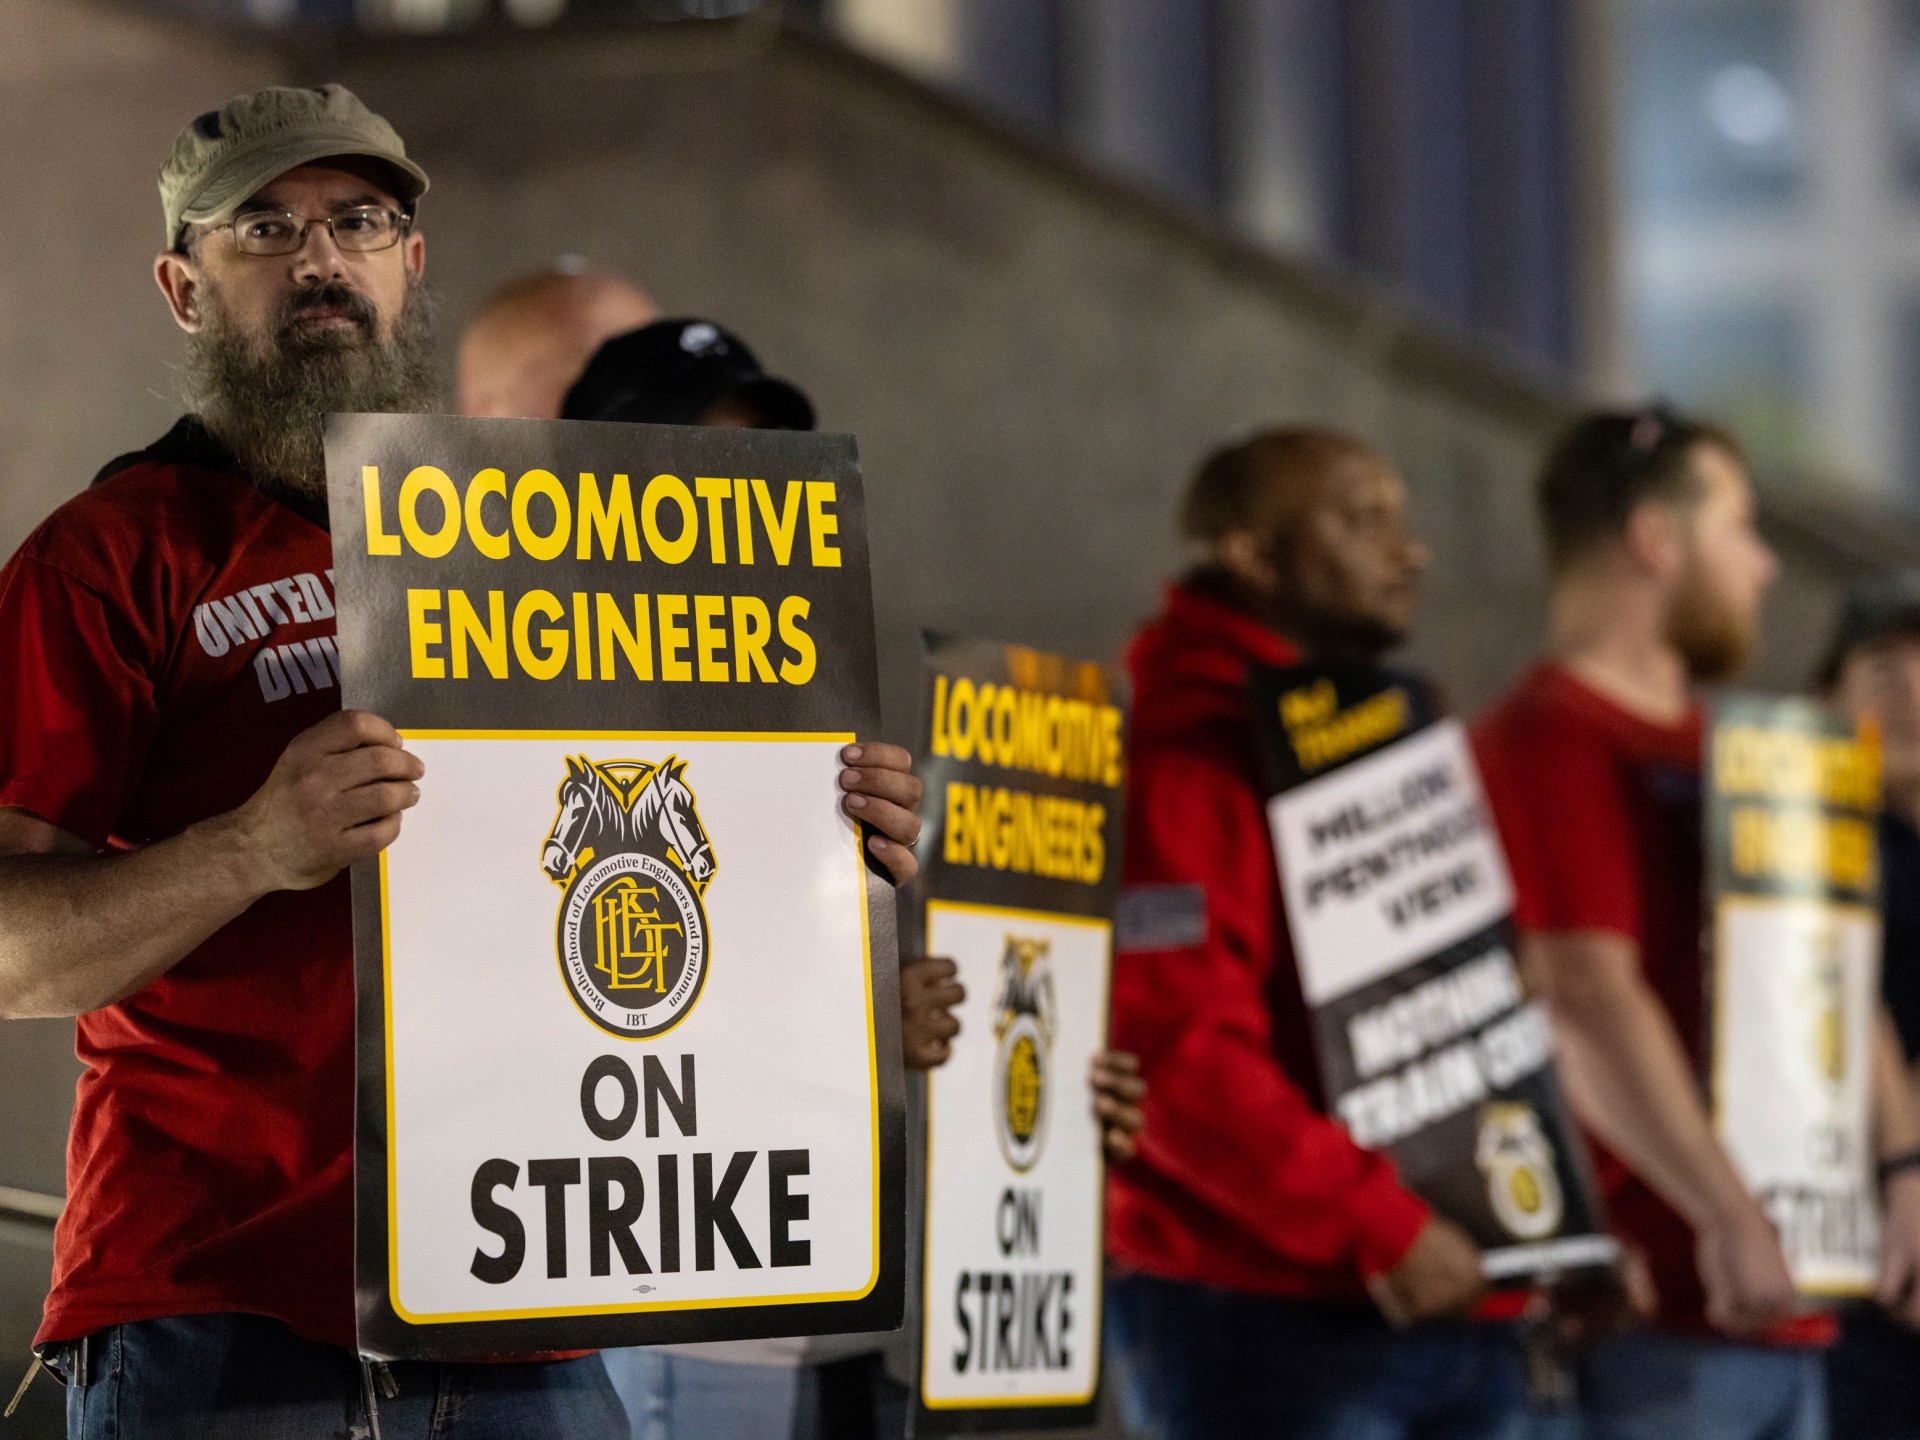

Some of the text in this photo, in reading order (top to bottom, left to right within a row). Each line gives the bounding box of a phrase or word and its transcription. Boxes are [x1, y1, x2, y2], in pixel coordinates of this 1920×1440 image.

[362, 464, 842, 568] LOCOMOTIVE
[192, 572, 336, 658] UNITED
[406, 588, 817, 685] ENGINEERS
[931, 674, 1122, 788] LOCOMOTIVE
[943, 781, 1105, 886] ENGINEERS
[567, 856, 700, 1012] Brotherhood of Locomotive Engineers and Trainmen
[625, 1013, 648, 1026] IBT
[580, 1053, 698, 1141] ON
[470, 1148, 812, 1285] STRIKE
[997, 1188, 1043, 1258] ON
[953, 1269, 1075, 1375] STRIKE
